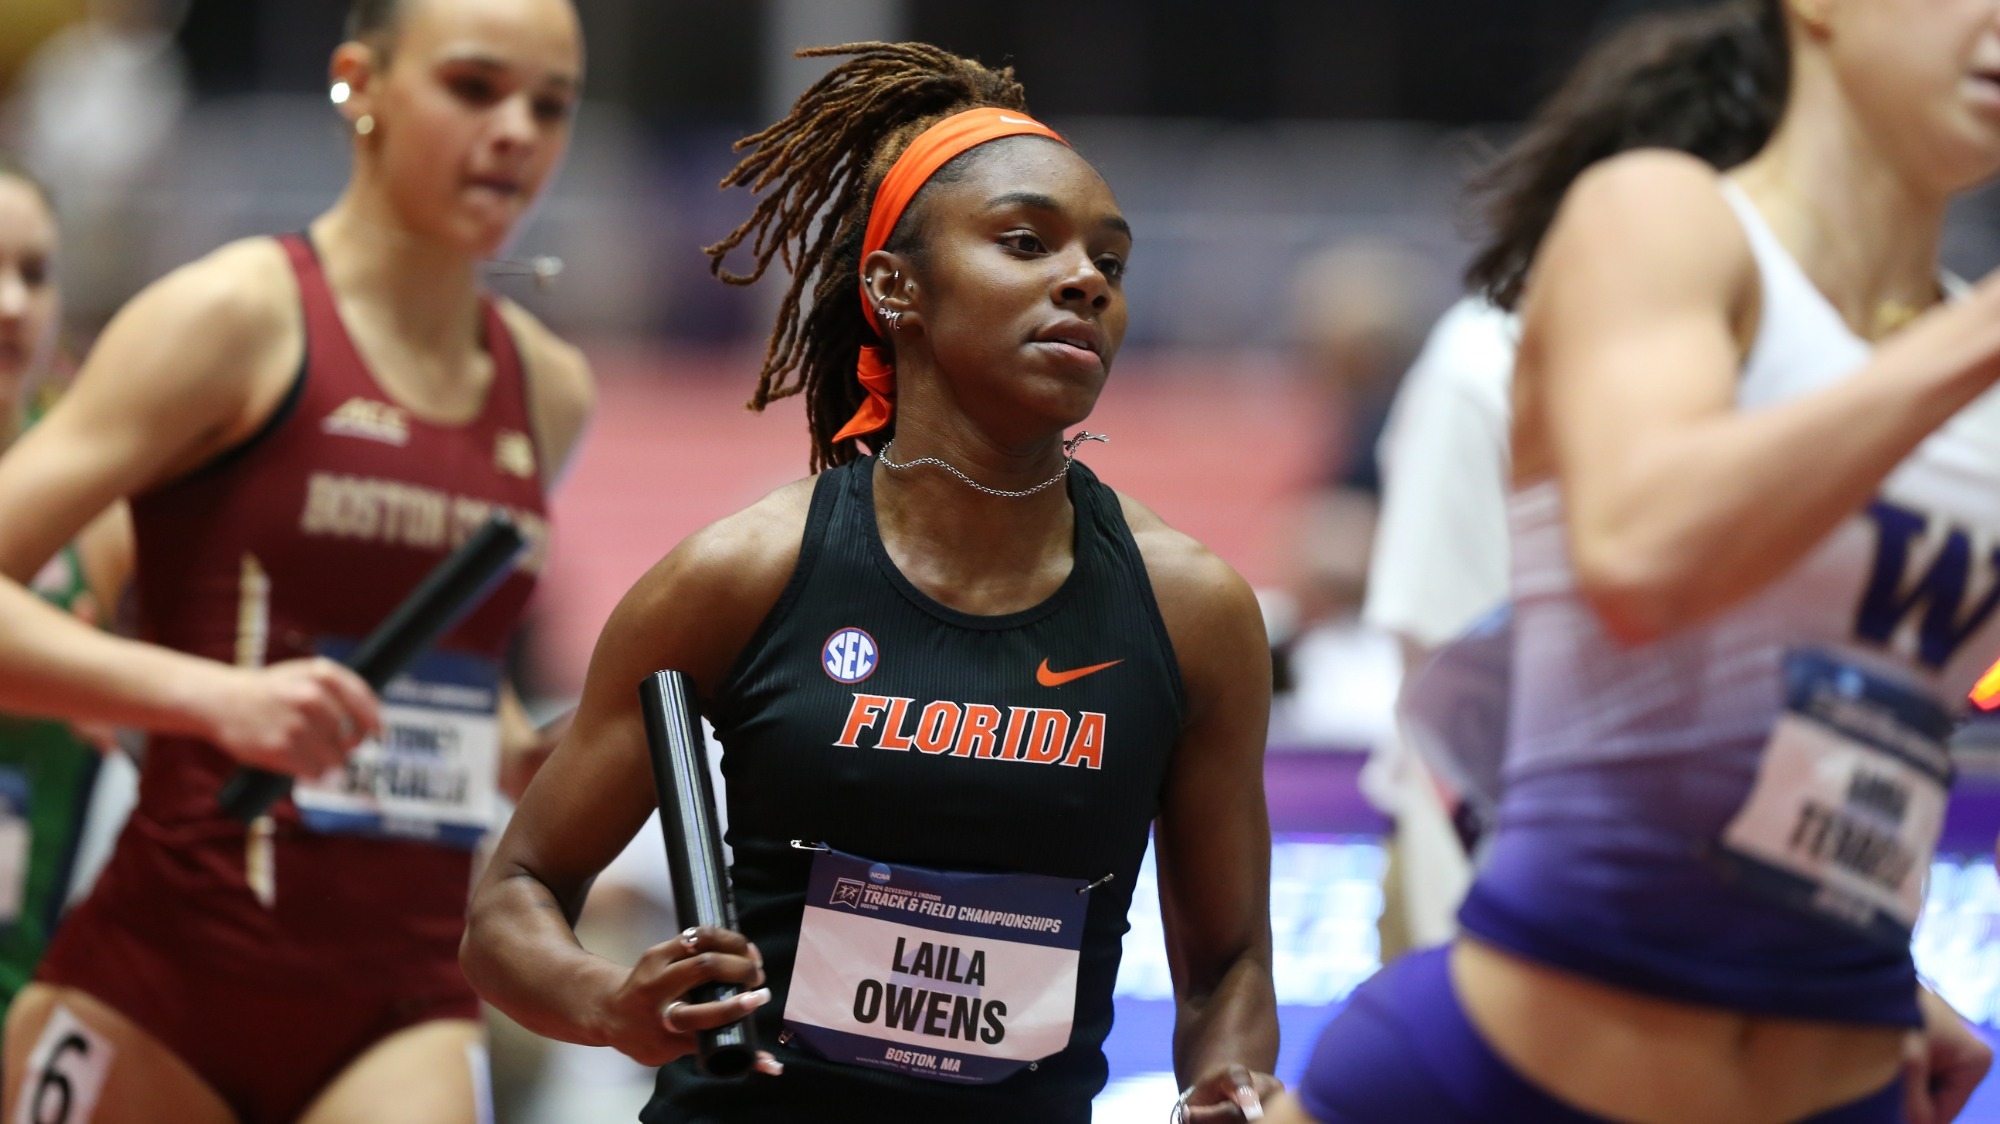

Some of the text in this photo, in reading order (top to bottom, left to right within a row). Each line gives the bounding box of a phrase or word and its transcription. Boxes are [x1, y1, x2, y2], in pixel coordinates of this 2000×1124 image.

[827, 631, 874, 680] SEC
[832, 693, 1106, 769] FLORIDA
[867, 883, 883, 892] 2024
[884, 886, 913, 897] DIVISION
[919, 892, 942, 902] INDOOR
[870, 871, 891, 881] NCAA
[863, 889, 1062, 933] TRACK & FIELD CHAMPIONSHIPS
[891, 936, 985, 986] LAILA
[852, 978, 1007, 1044] OWENS
[31, 1033, 89, 1124] 6
[885, 1047, 937, 1070] BOSTON,
[940, 1057, 962, 1073] MA
